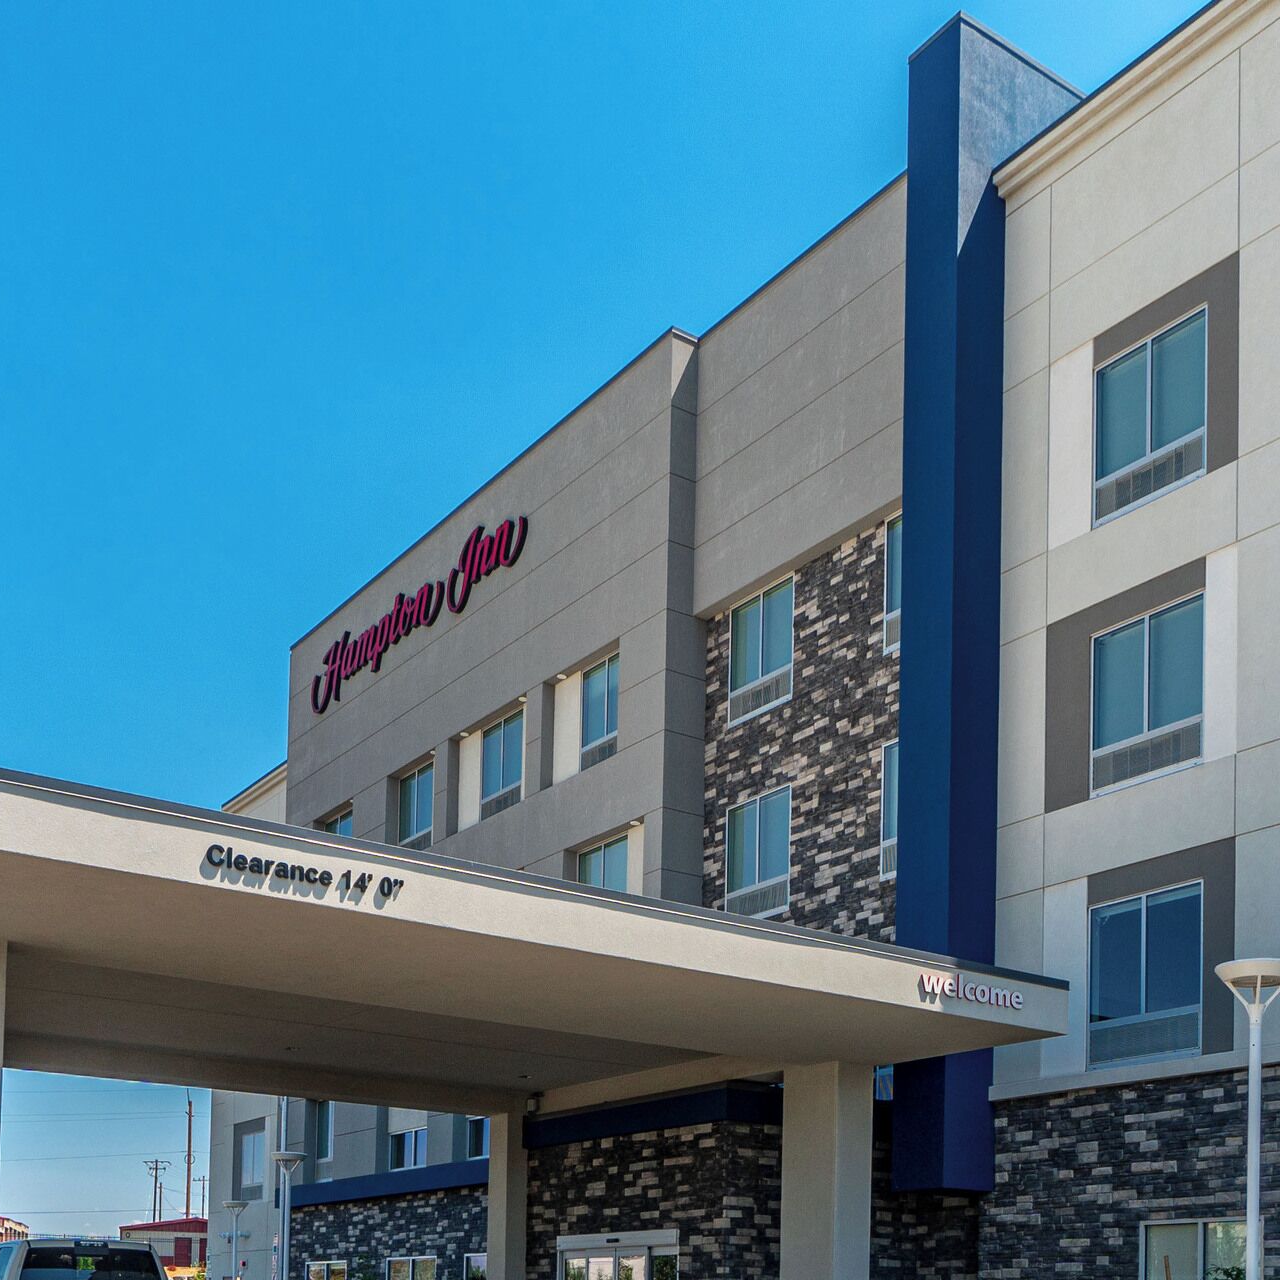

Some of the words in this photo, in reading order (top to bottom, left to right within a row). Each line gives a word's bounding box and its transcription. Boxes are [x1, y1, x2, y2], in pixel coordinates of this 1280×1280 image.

[310, 581, 445, 715] Hampton
[447, 516, 529, 615] Inn
[206, 843, 333, 886] Clearance
[920, 973, 1024, 1010] welcome
